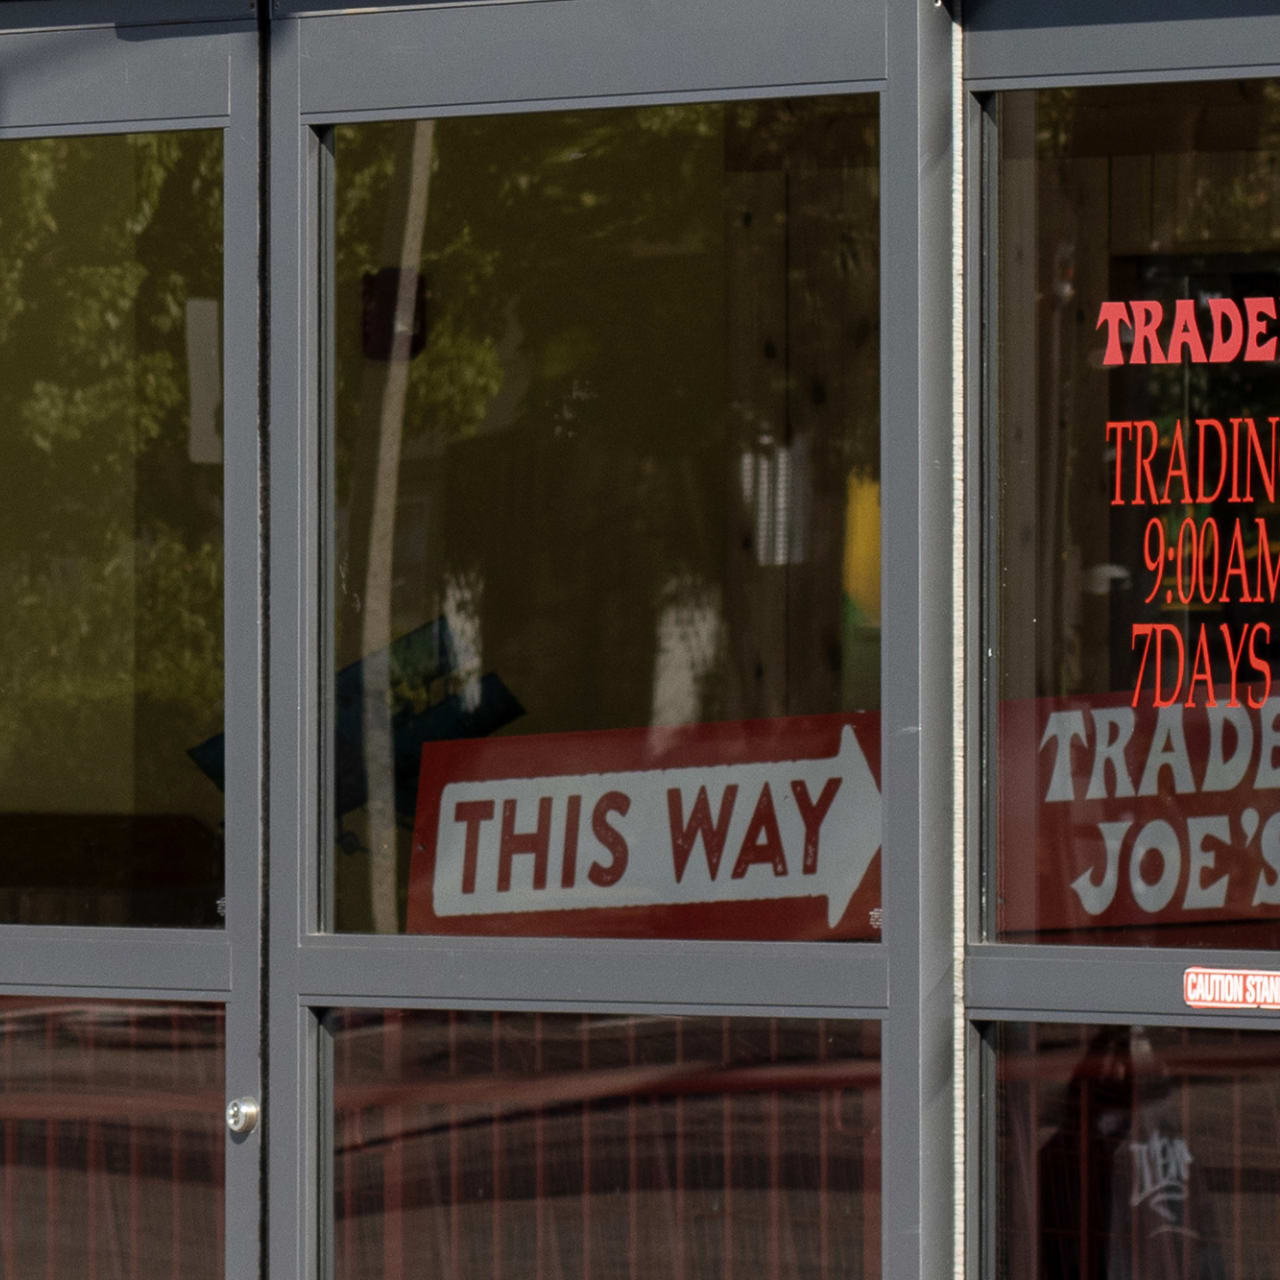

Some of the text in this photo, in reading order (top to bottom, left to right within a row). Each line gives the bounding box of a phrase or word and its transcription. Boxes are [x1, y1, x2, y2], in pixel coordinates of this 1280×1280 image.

[1095, 296, 1279, 365] TRADE
[1105, 416, 1280, 506] TRADIN
[1143, 517, 1280, 605] 9:00AM
[1038, 695, 1280, 803] TRADE
[453, 777, 844, 895] THIS WAY
[1187, 972, 1244, 1002] CAUTION
